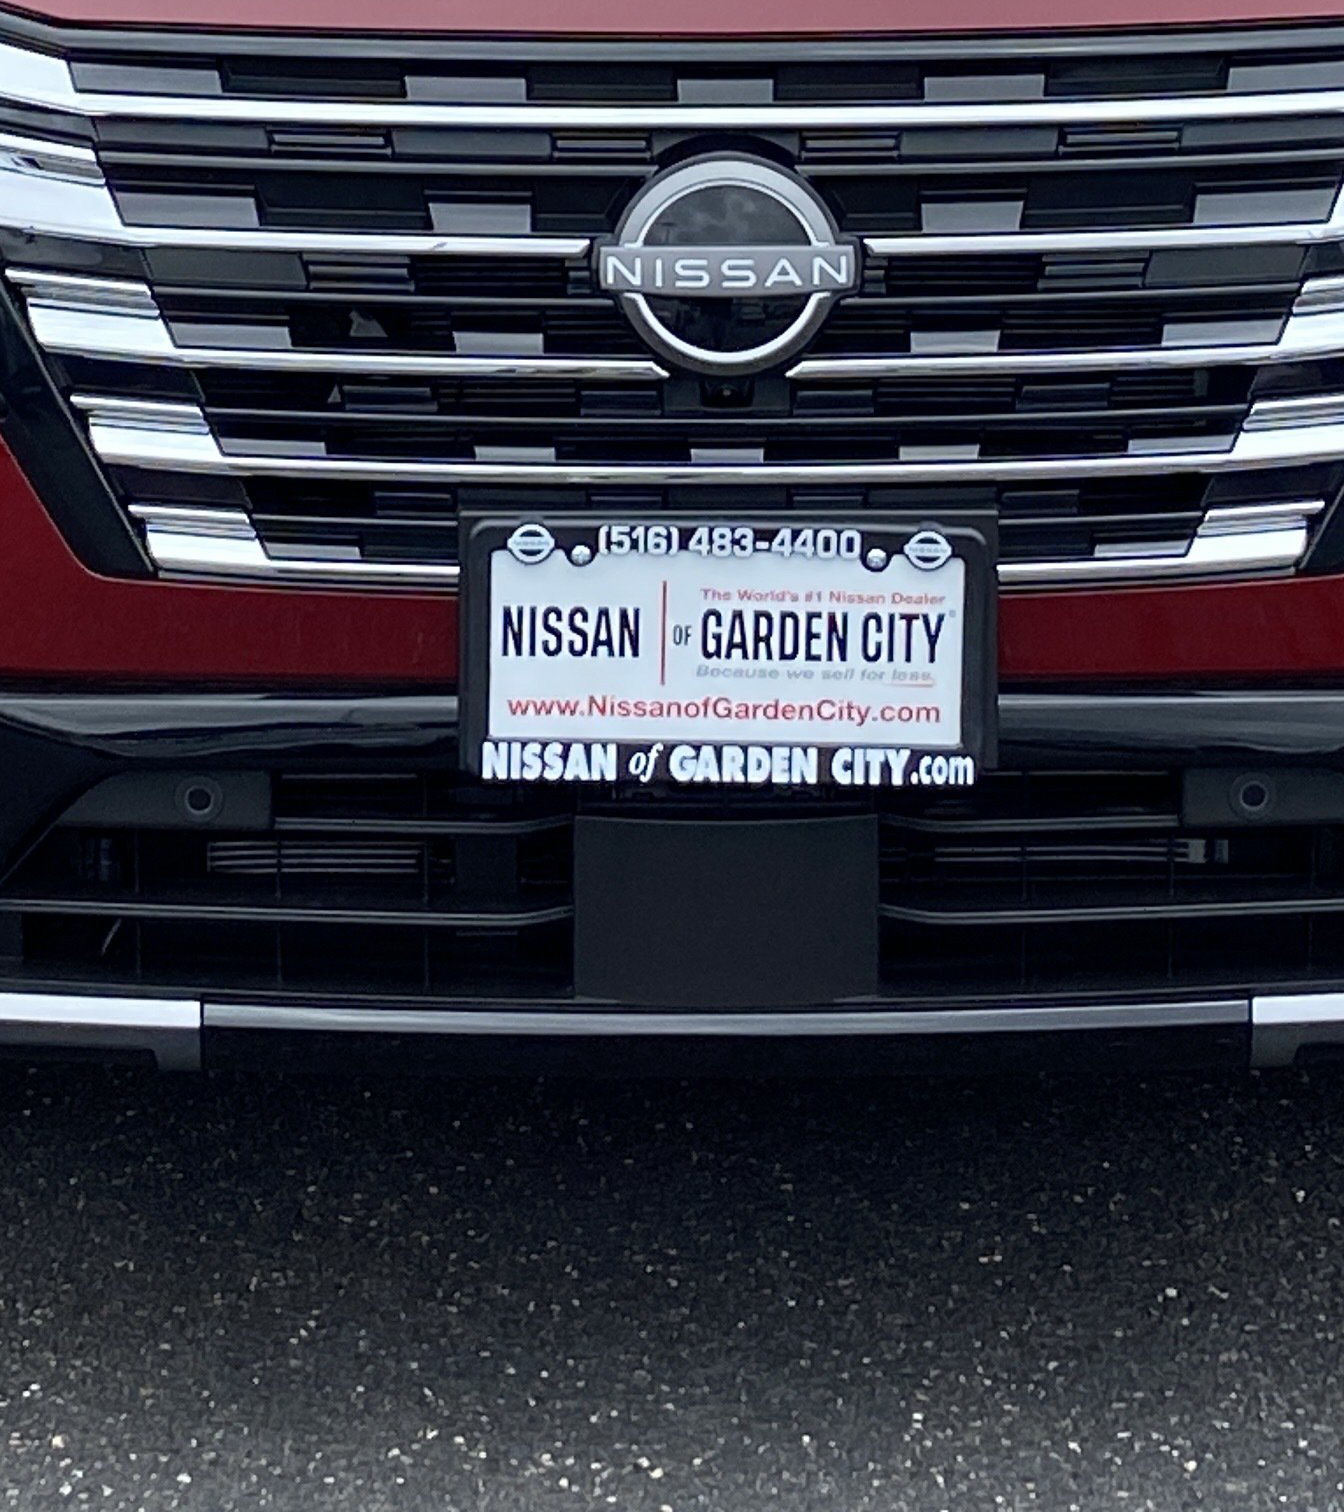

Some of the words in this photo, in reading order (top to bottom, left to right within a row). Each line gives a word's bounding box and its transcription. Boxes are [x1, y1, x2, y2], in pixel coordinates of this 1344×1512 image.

[606, 255, 848, 288] NISSAN
[598, 525, 679, 557] (516)
[688, 526, 861, 559] 483-4400
[700, 588, 731, 601] The
[738, 589, 799, 602] World's
[805, 590, 822, 603] #1
[829, 591, 885, 604] Nissan
[891, 592, 946, 605] Dealer
[501, 605, 641, 658] NISSAN
[672, 624, 692, 646] OF
[701, 608, 849, 662] GARDEN
[861, 611, 946, 664] CITY
[696, 665, 780, 680] Because
[786, 668, 814, 680] we
[821, 667, 855, 681] sell
[860, 668, 886, 682] for
[506, 694, 941, 726] www.NissanofGardenCity.com
[481, 741, 618, 781] NISSAN
[628, 742, 664, 784] of
[669, 744, 819, 785] GARDEN
[830, 747, 976, 787] CITY.com
